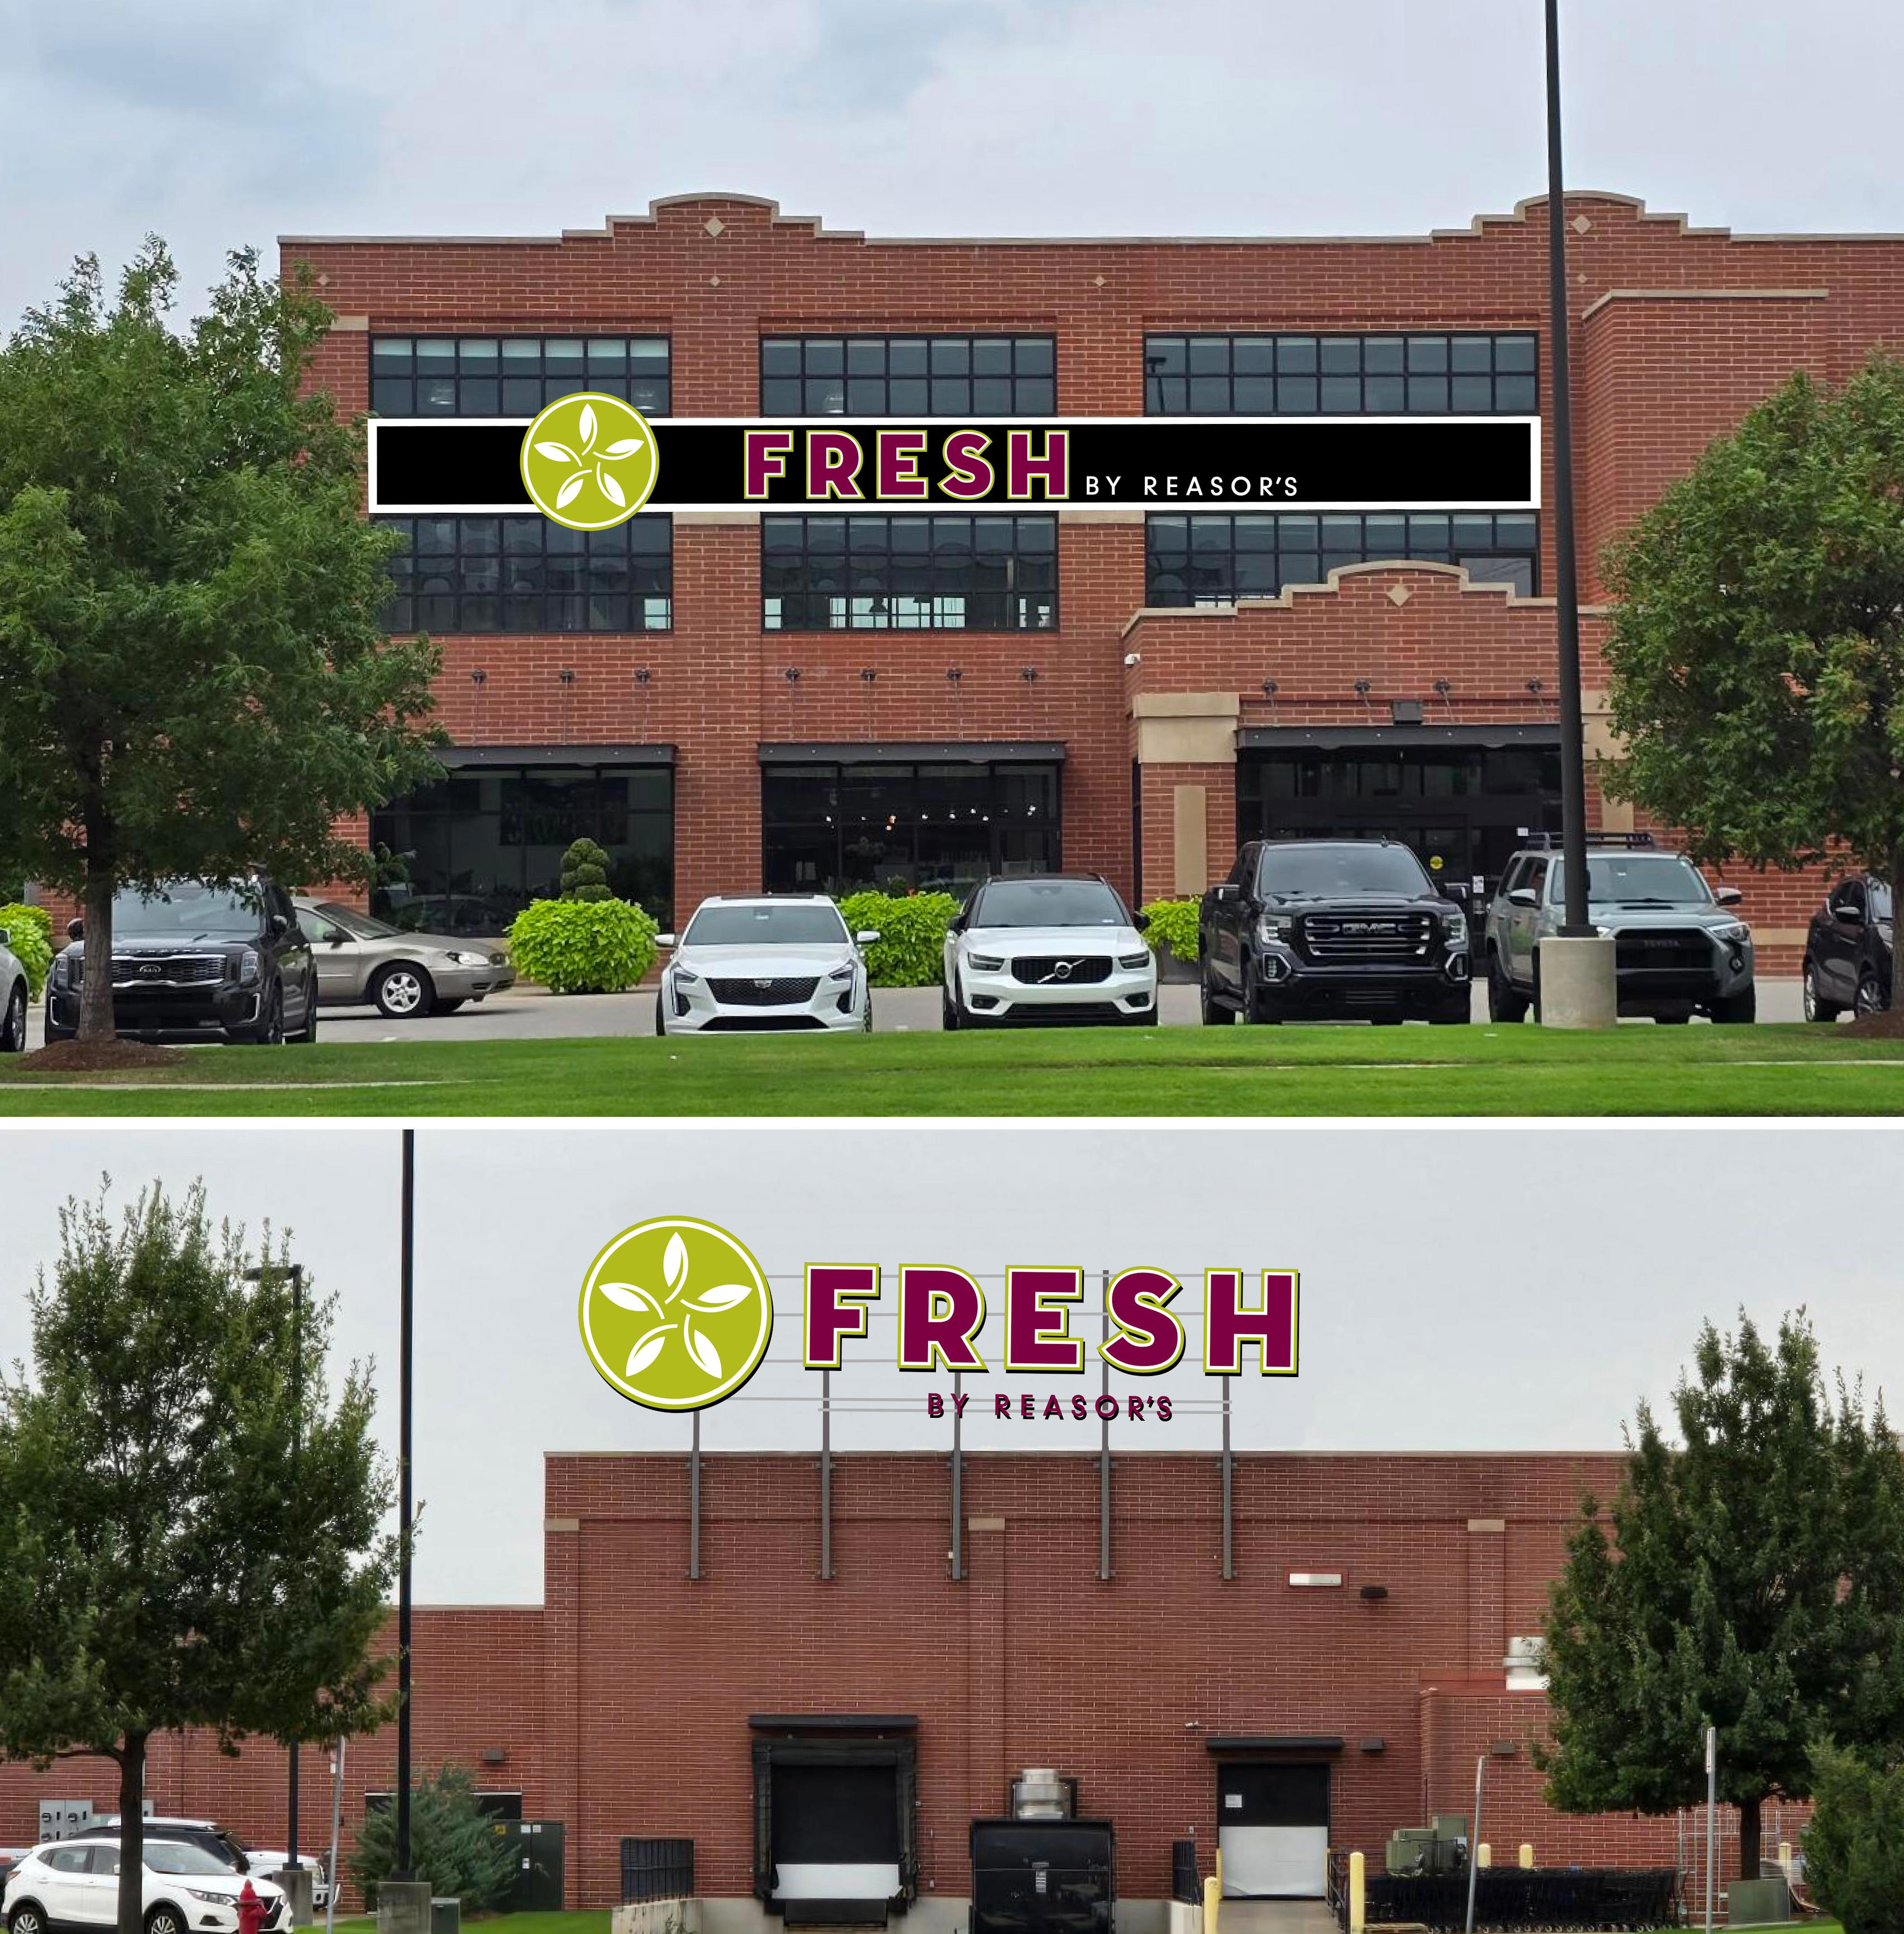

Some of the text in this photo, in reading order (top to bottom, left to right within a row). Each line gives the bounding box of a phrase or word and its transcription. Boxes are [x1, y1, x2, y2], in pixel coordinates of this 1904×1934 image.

[744, 430, 1297, 499] FRESH BY REASOR'S
[803, 1263, 1301, 1376] FRESH
[928, 1393, 1173, 1421] BY REASOR'S
